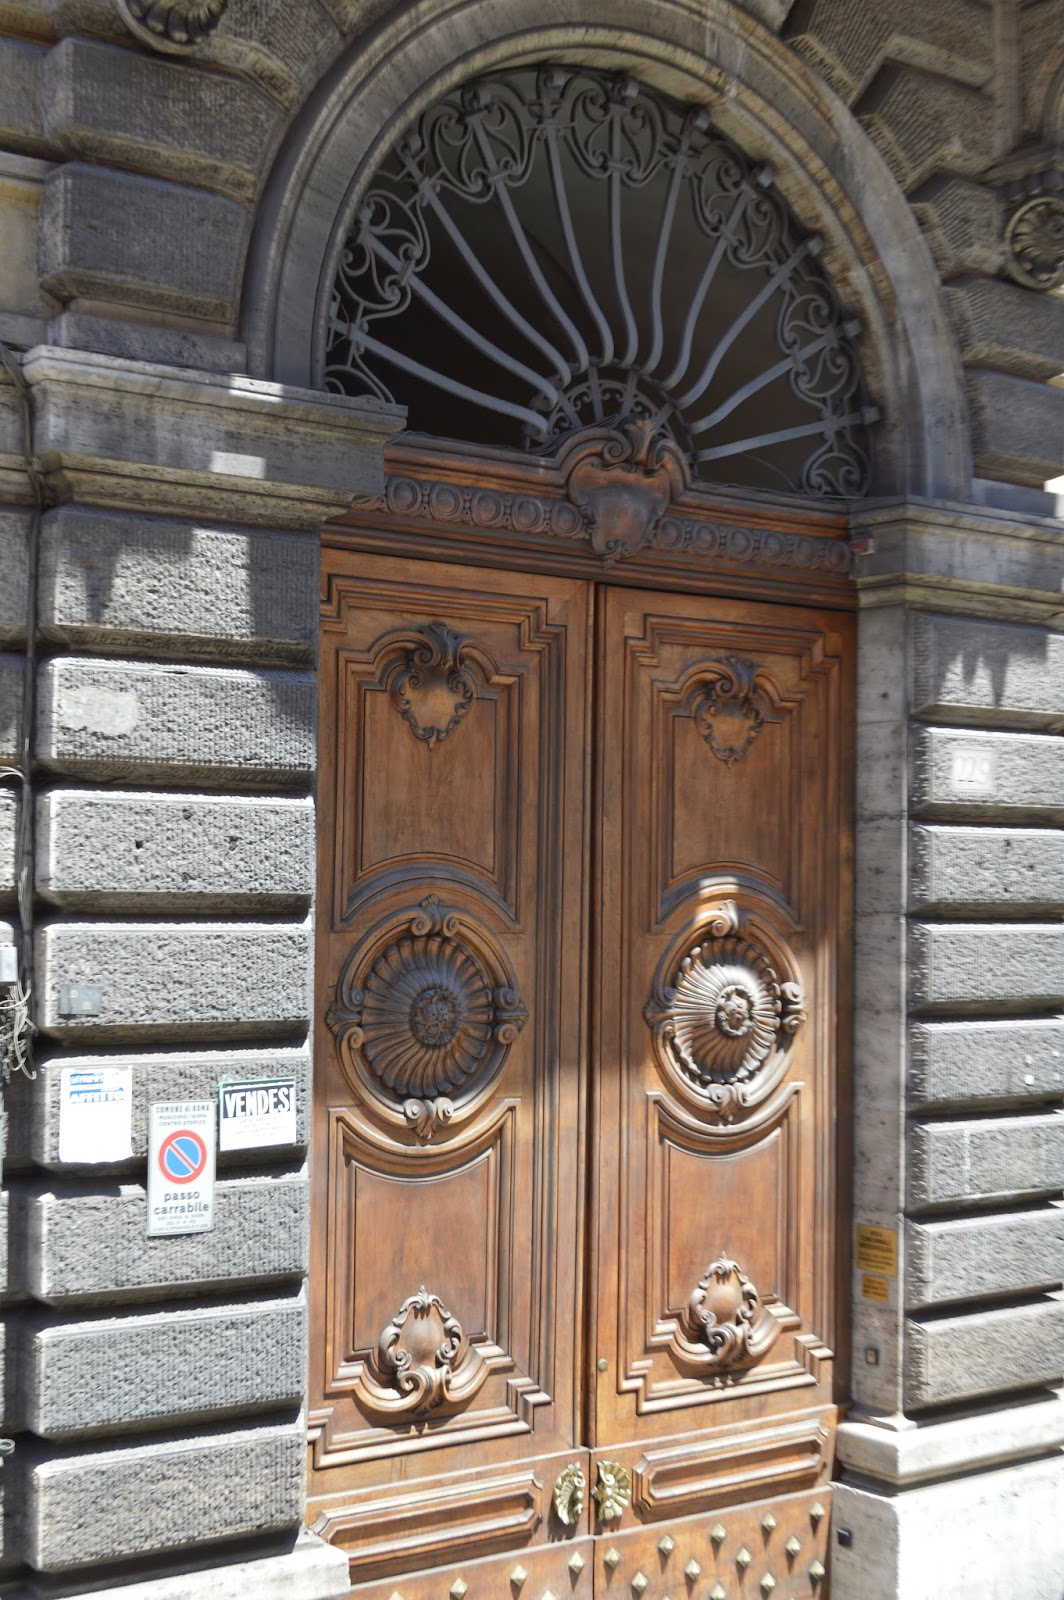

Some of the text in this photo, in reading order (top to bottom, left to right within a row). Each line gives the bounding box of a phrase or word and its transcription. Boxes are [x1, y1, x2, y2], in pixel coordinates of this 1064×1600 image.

[224, 1087, 295, 1118] VENDESI
[156, 1105, 182, 1113] COMUNE
[163, 1191, 200, 1203] passo
[154, 1202, 209, 1215] carrabile
